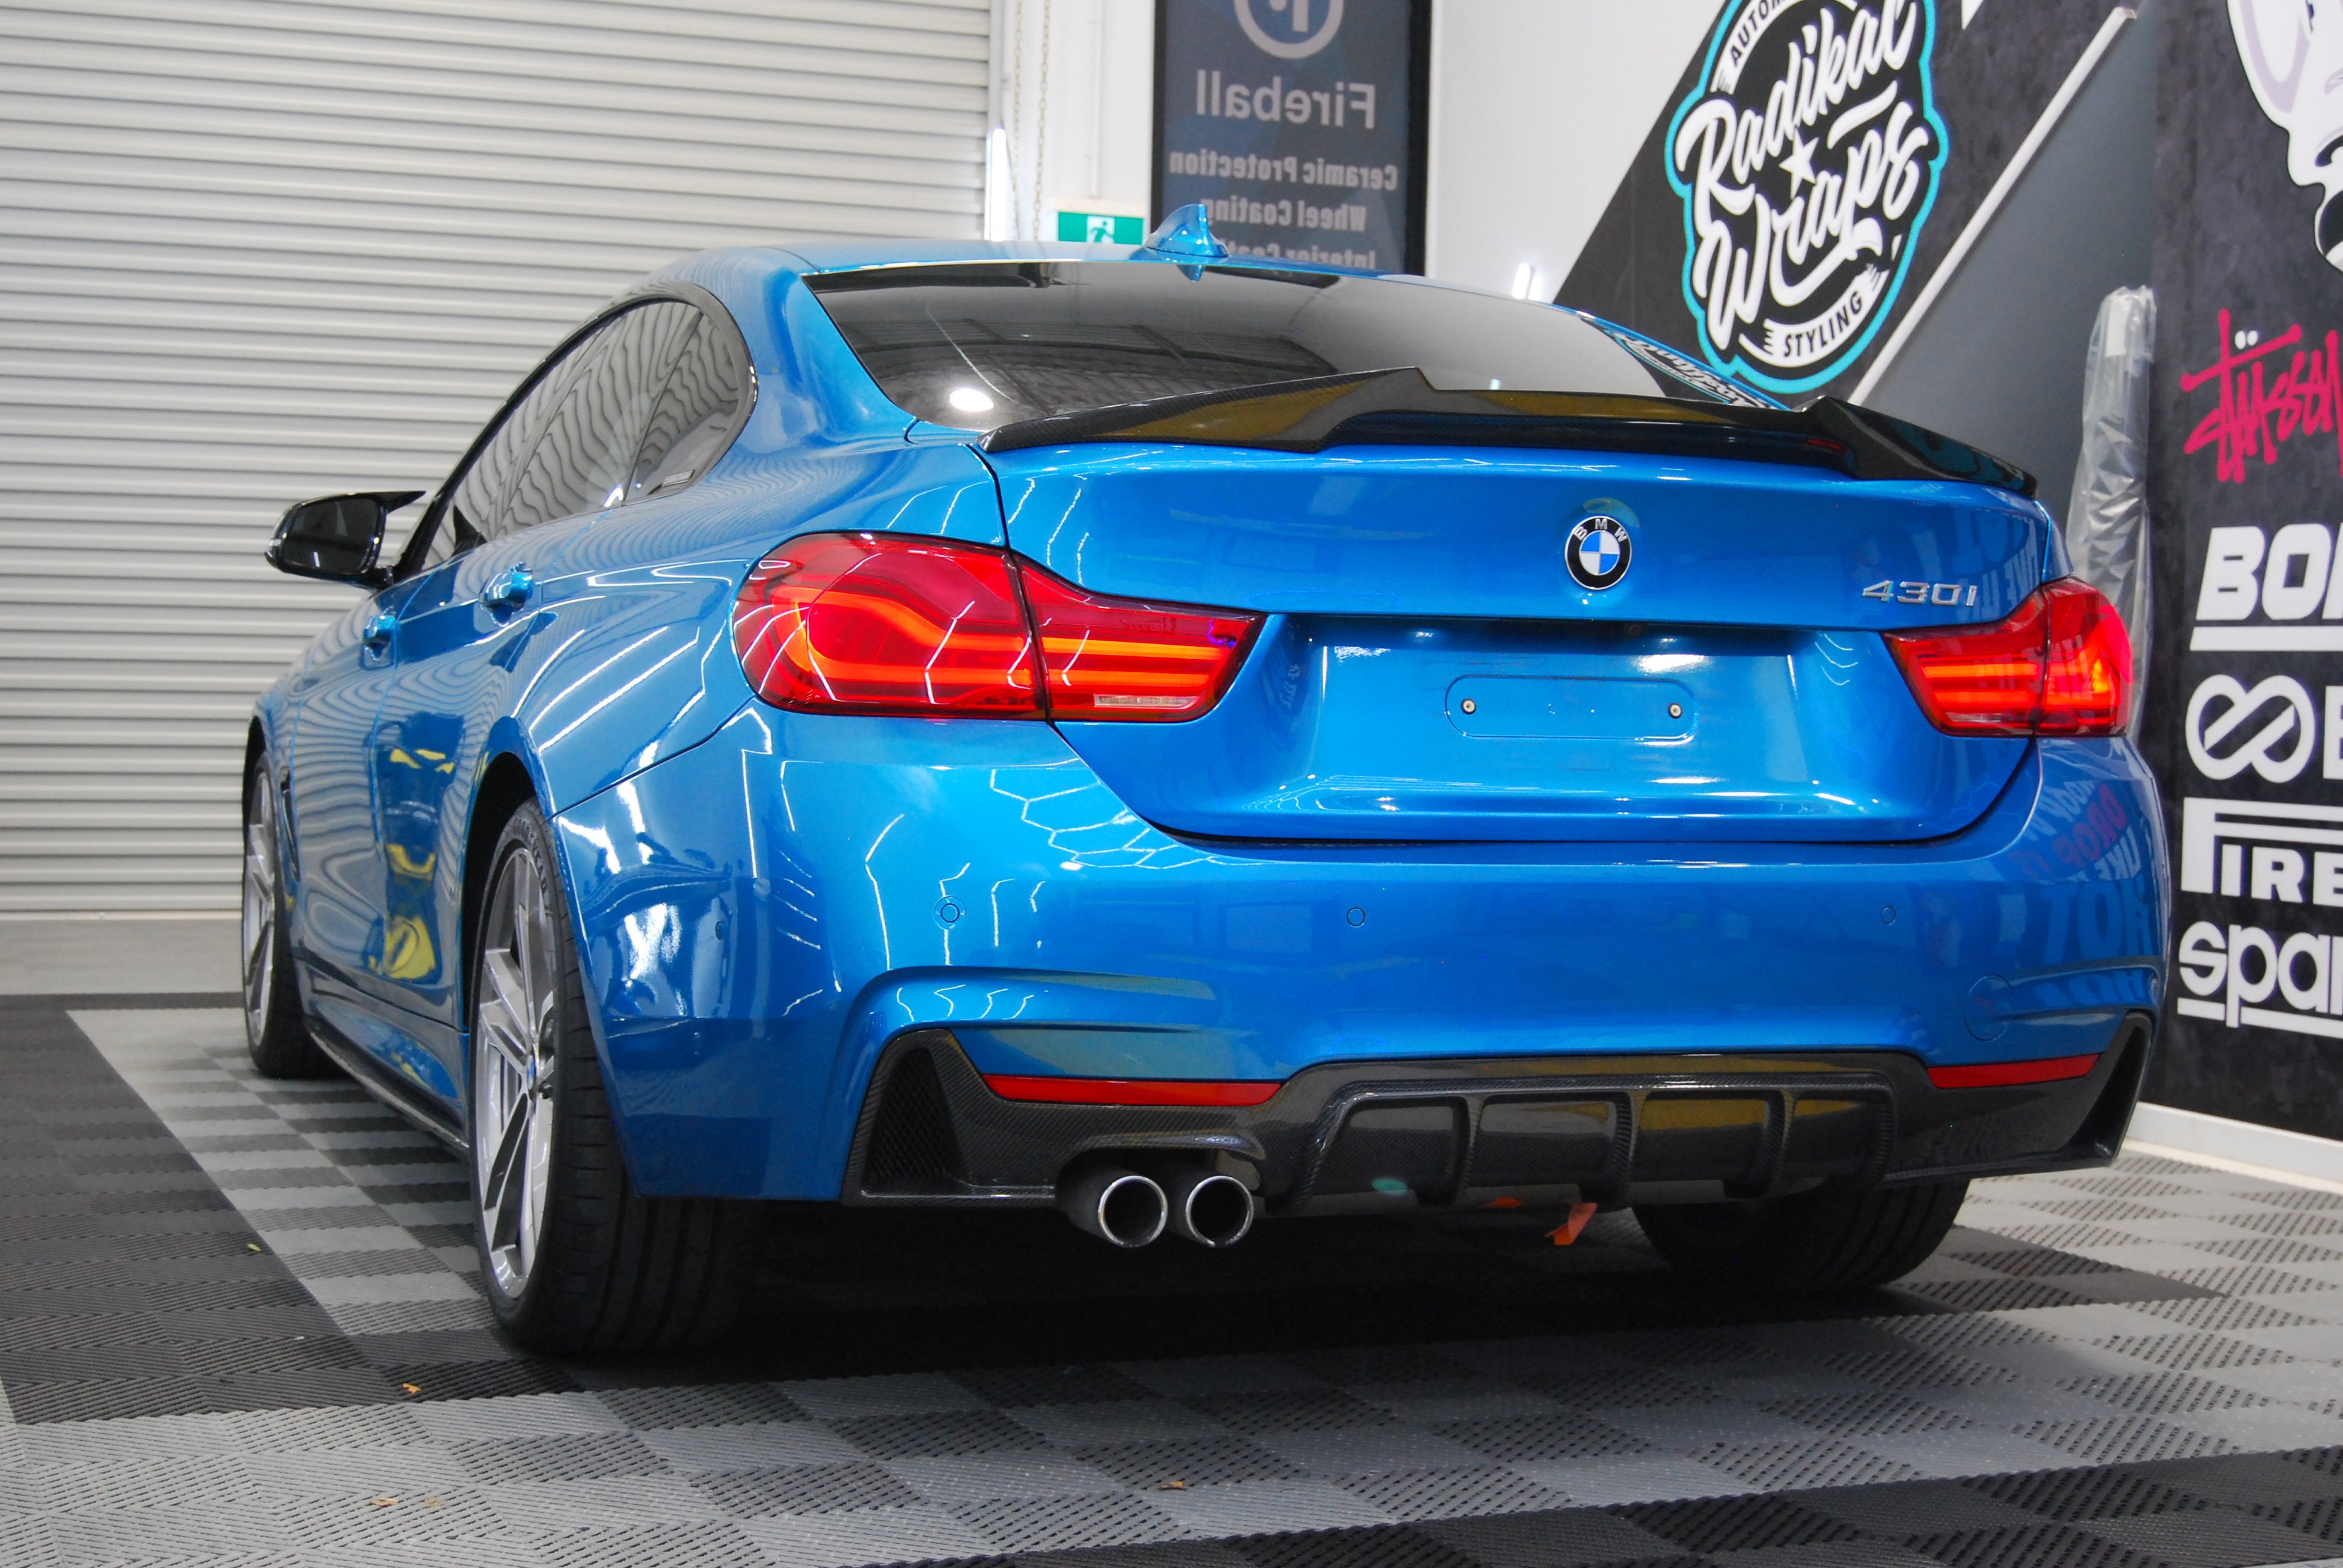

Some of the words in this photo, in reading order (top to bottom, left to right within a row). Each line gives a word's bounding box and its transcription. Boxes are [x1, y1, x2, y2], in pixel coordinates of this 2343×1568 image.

[1675, 0, 1917, 238] Radikal
[1693, 101, 1929, 350] Wraps
[1784, 289, 1863, 358] STYLING
[1573, 518, 1628, 542] BMW
[2195, 522, 2343, 621] BO
[1862, 579, 1978, 607] 430i
